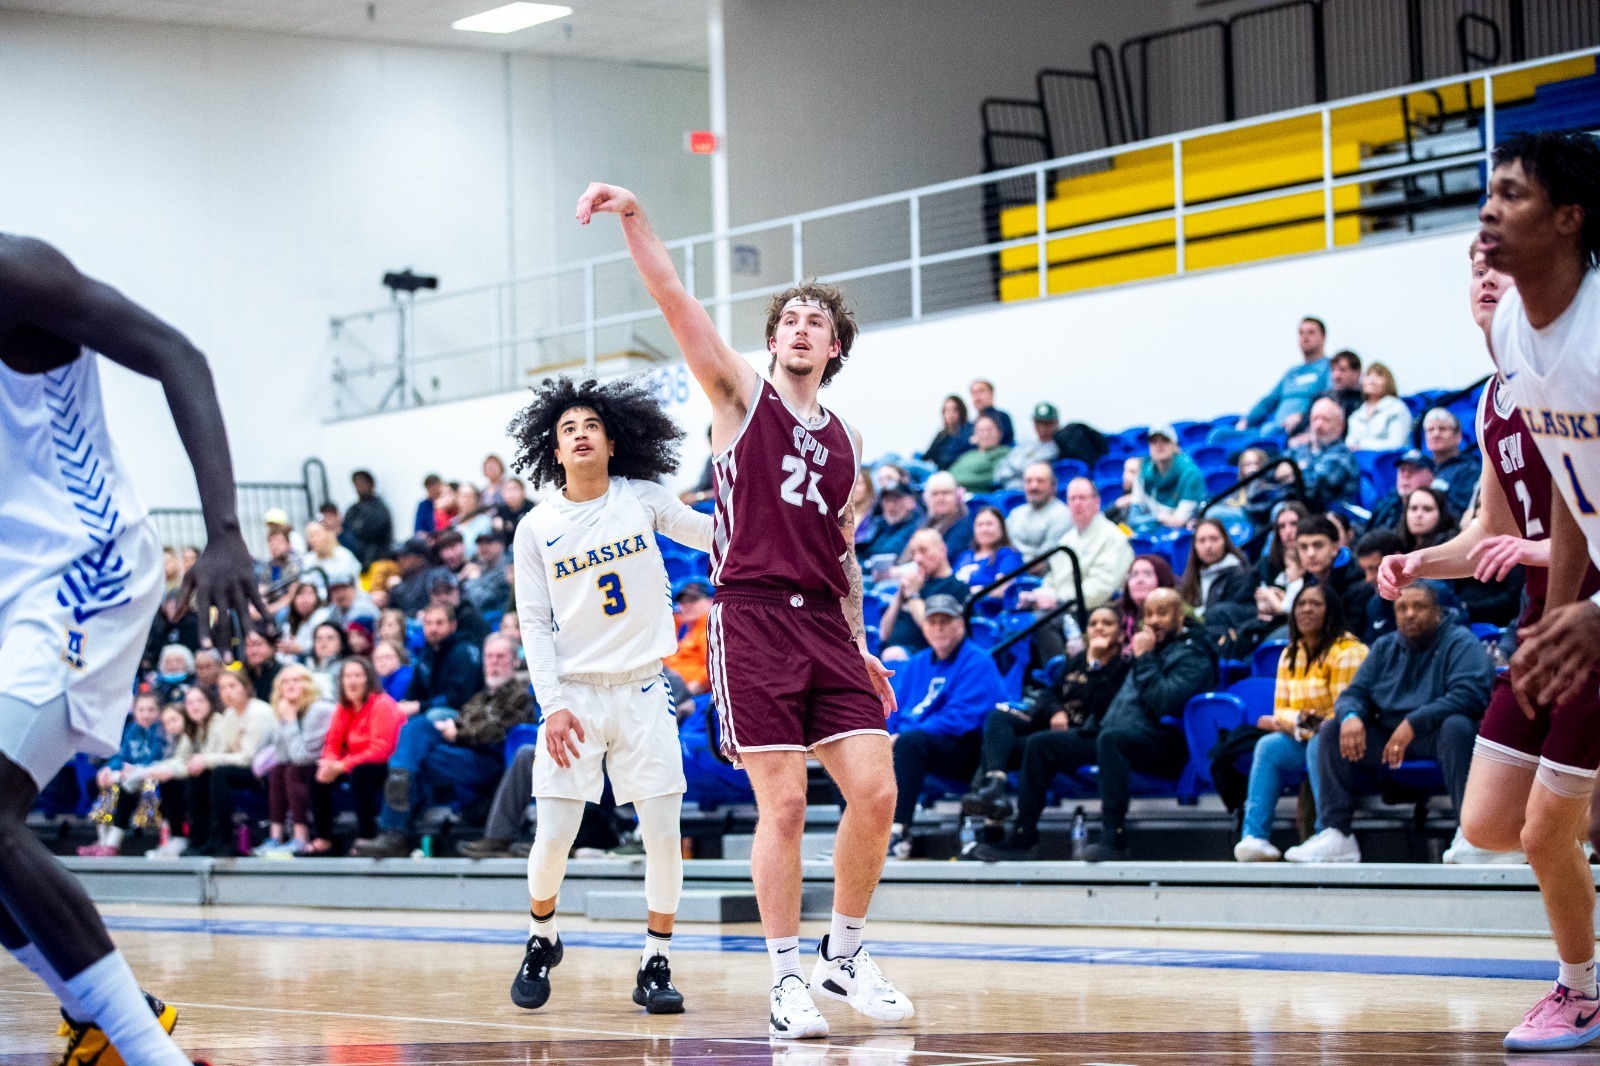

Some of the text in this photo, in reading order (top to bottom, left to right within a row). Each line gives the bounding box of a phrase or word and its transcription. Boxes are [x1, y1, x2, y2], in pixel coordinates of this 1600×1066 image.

[792, 425, 829, 467] SPU
[1518, 408, 1600, 441] LASK
[1562, 452, 1598, 516] 1
[553, 533, 649, 580] ALASKA
[597, 571, 628, 617] 3
